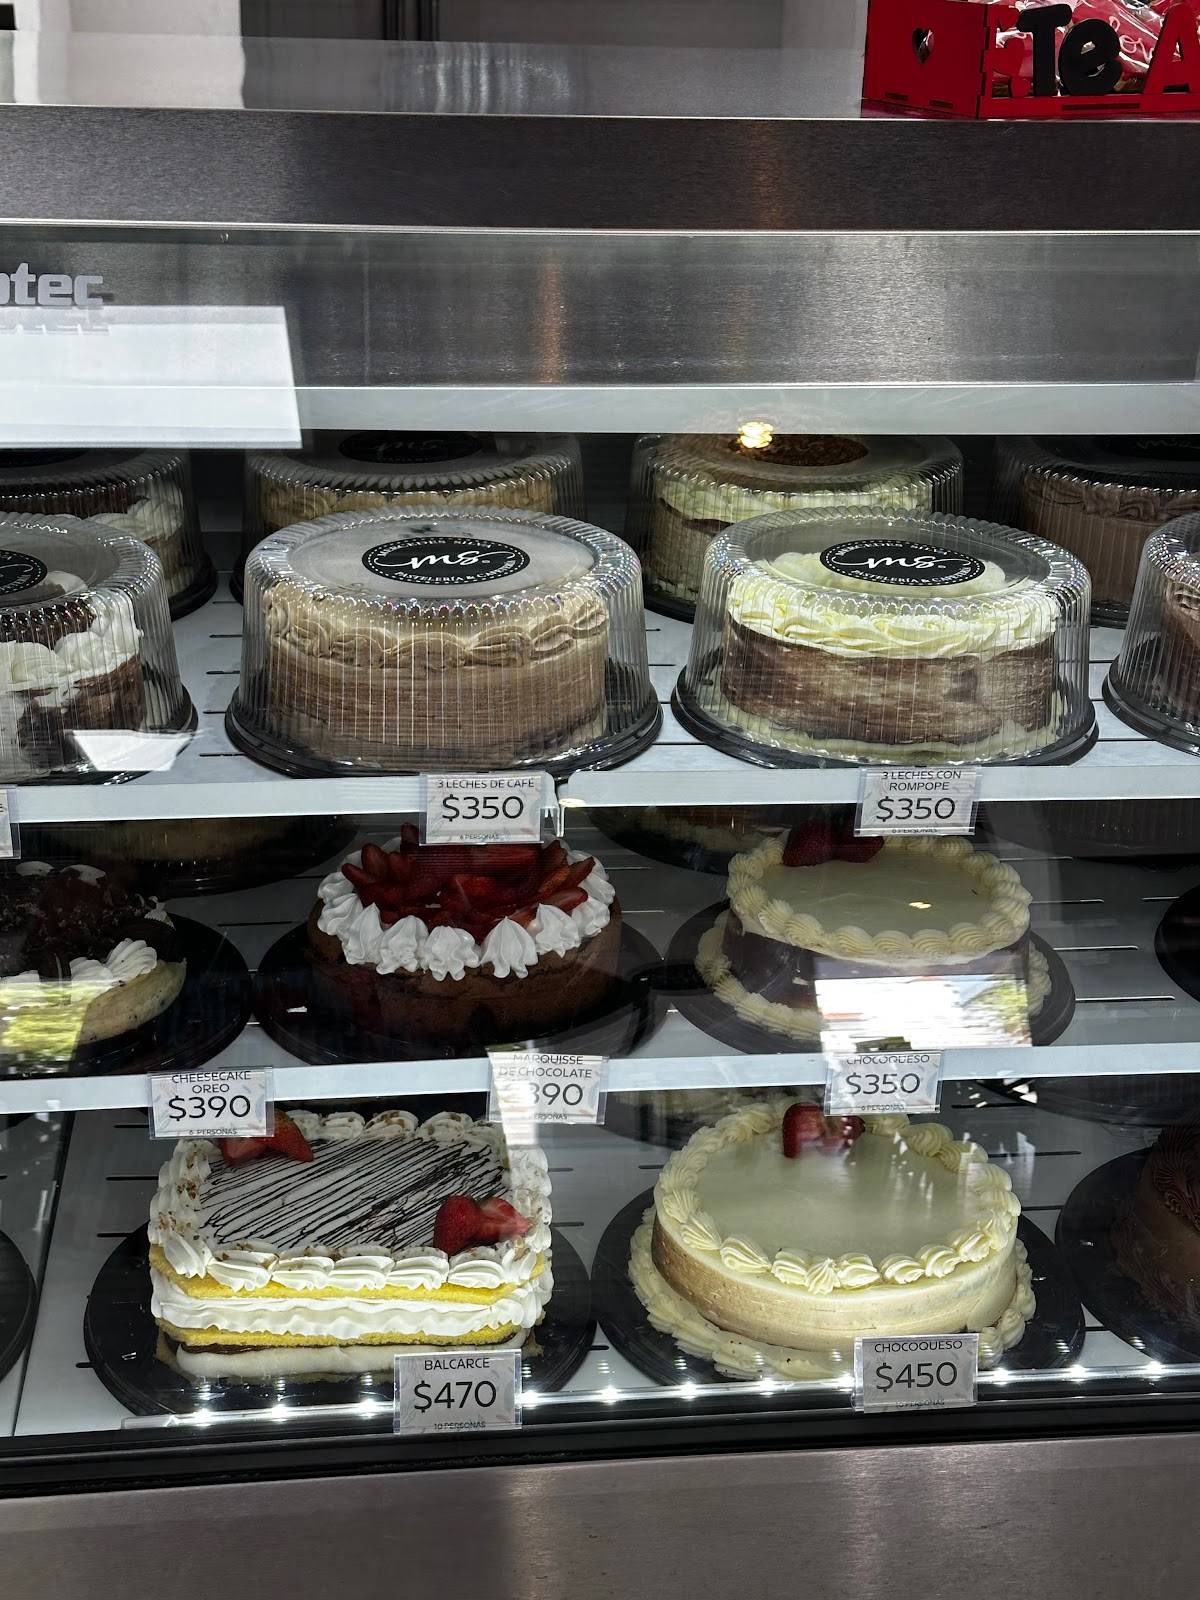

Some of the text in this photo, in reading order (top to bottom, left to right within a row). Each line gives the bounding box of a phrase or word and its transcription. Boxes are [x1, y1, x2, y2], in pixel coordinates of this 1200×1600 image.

[1016, 3, 1123, 96] Te
[881, 770, 962, 780] 3 LECHES CON
[438, 779, 444, 789] 3
[446, 779, 487, 789] LECHES
[489, 779, 505, 789] DE
[889, 781, 950, 791] ROMPOPE
[441, 794, 524, 822] $350
[876, 796, 956, 822] $350
[513, 1054, 584, 1066] MARQUISSE
[846, 1055, 930, 1065] CHOCOQUESO
[171, 1071, 252, 1084] CHEESECAKE
[499, 1067, 592, 1079] DE CHOCOLATE
[192, 1083, 230, 1094] OREO
[845, 1072, 921, 1095] $350
[168, 1095, 251, 1122] $390
[874, 1340, 963, 1353] CHOCOQUESO
[424, 1357, 490, 1371] BALCARCE
[875, 1362, 958, 1393] $450
[413, 1380, 497, 1414] $470
